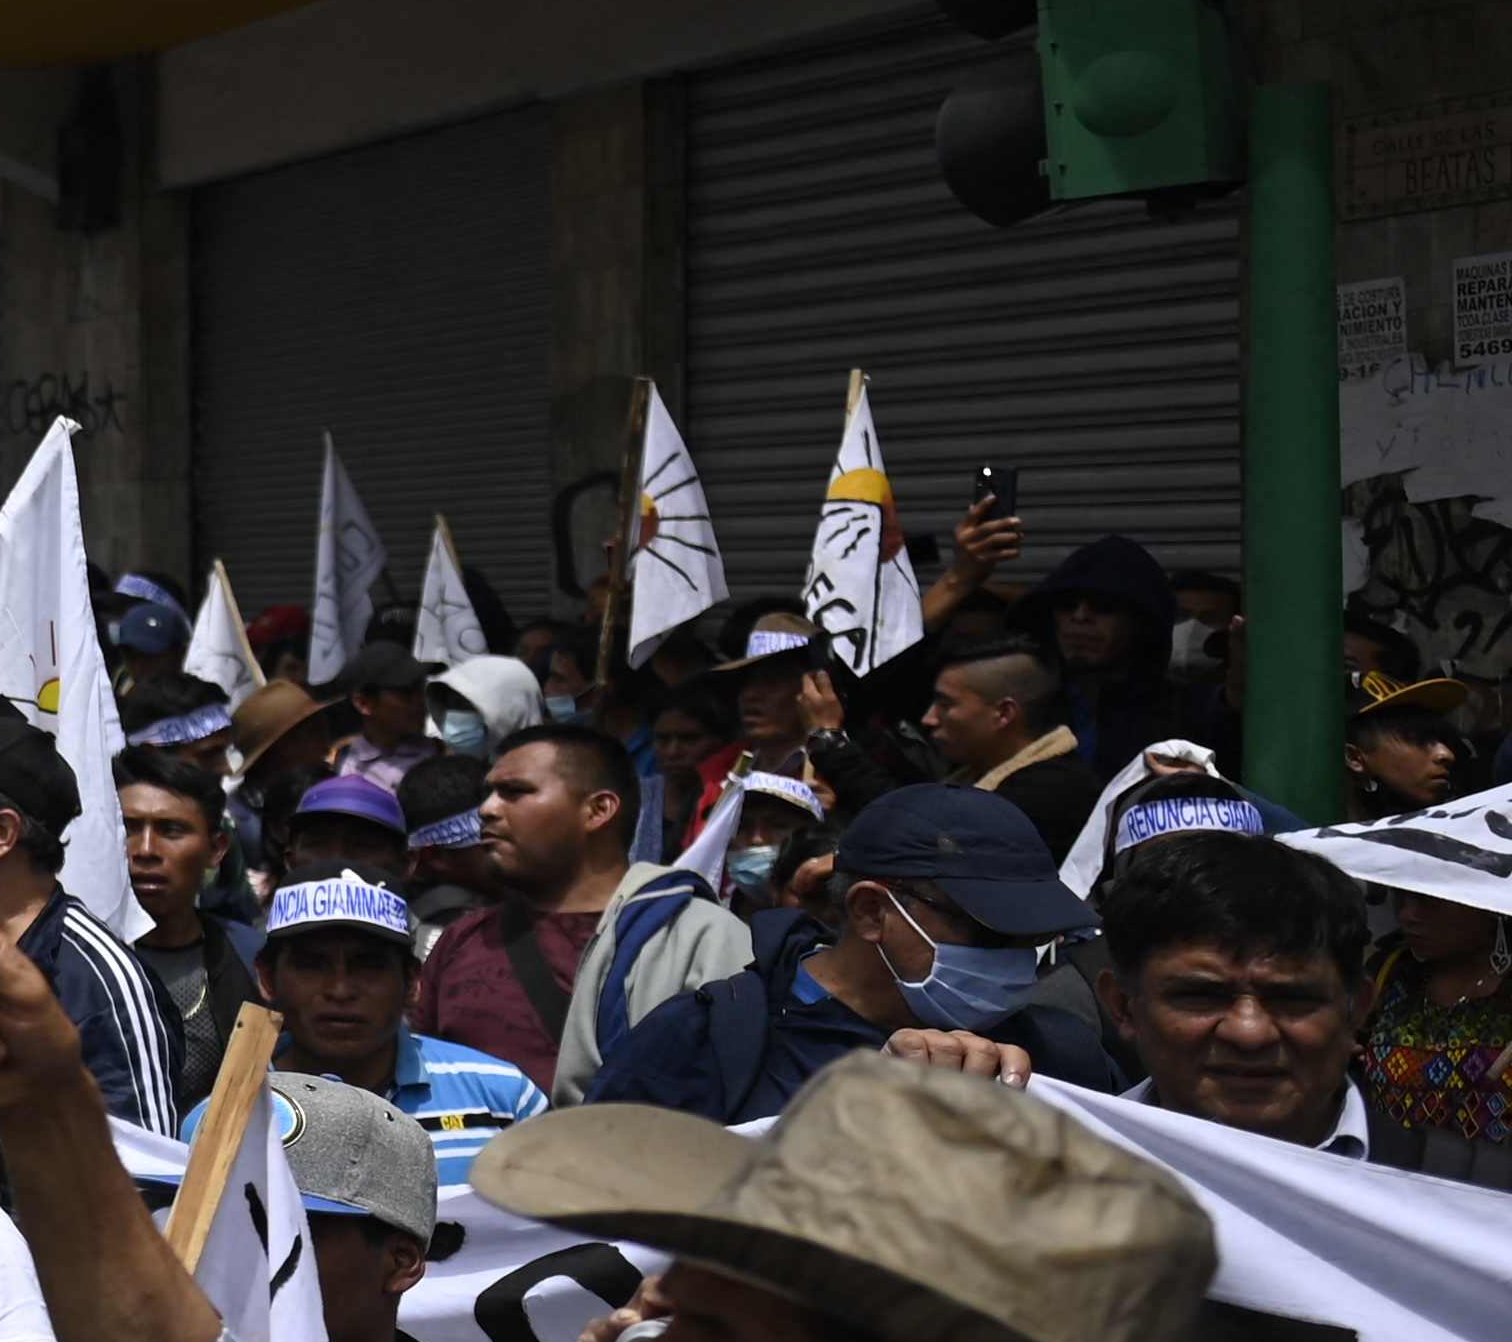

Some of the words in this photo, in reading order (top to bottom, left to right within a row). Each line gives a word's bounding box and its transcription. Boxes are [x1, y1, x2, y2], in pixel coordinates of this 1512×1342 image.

[1460, 119, 1496, 142] LAS
[1406, 147, 1496, 195] BEATAS
[1393, 300, 1402, 314] Y
[1127, 798, 1214, 844] RENUNCIA
[440, 1114, 465, 1131] CAT
